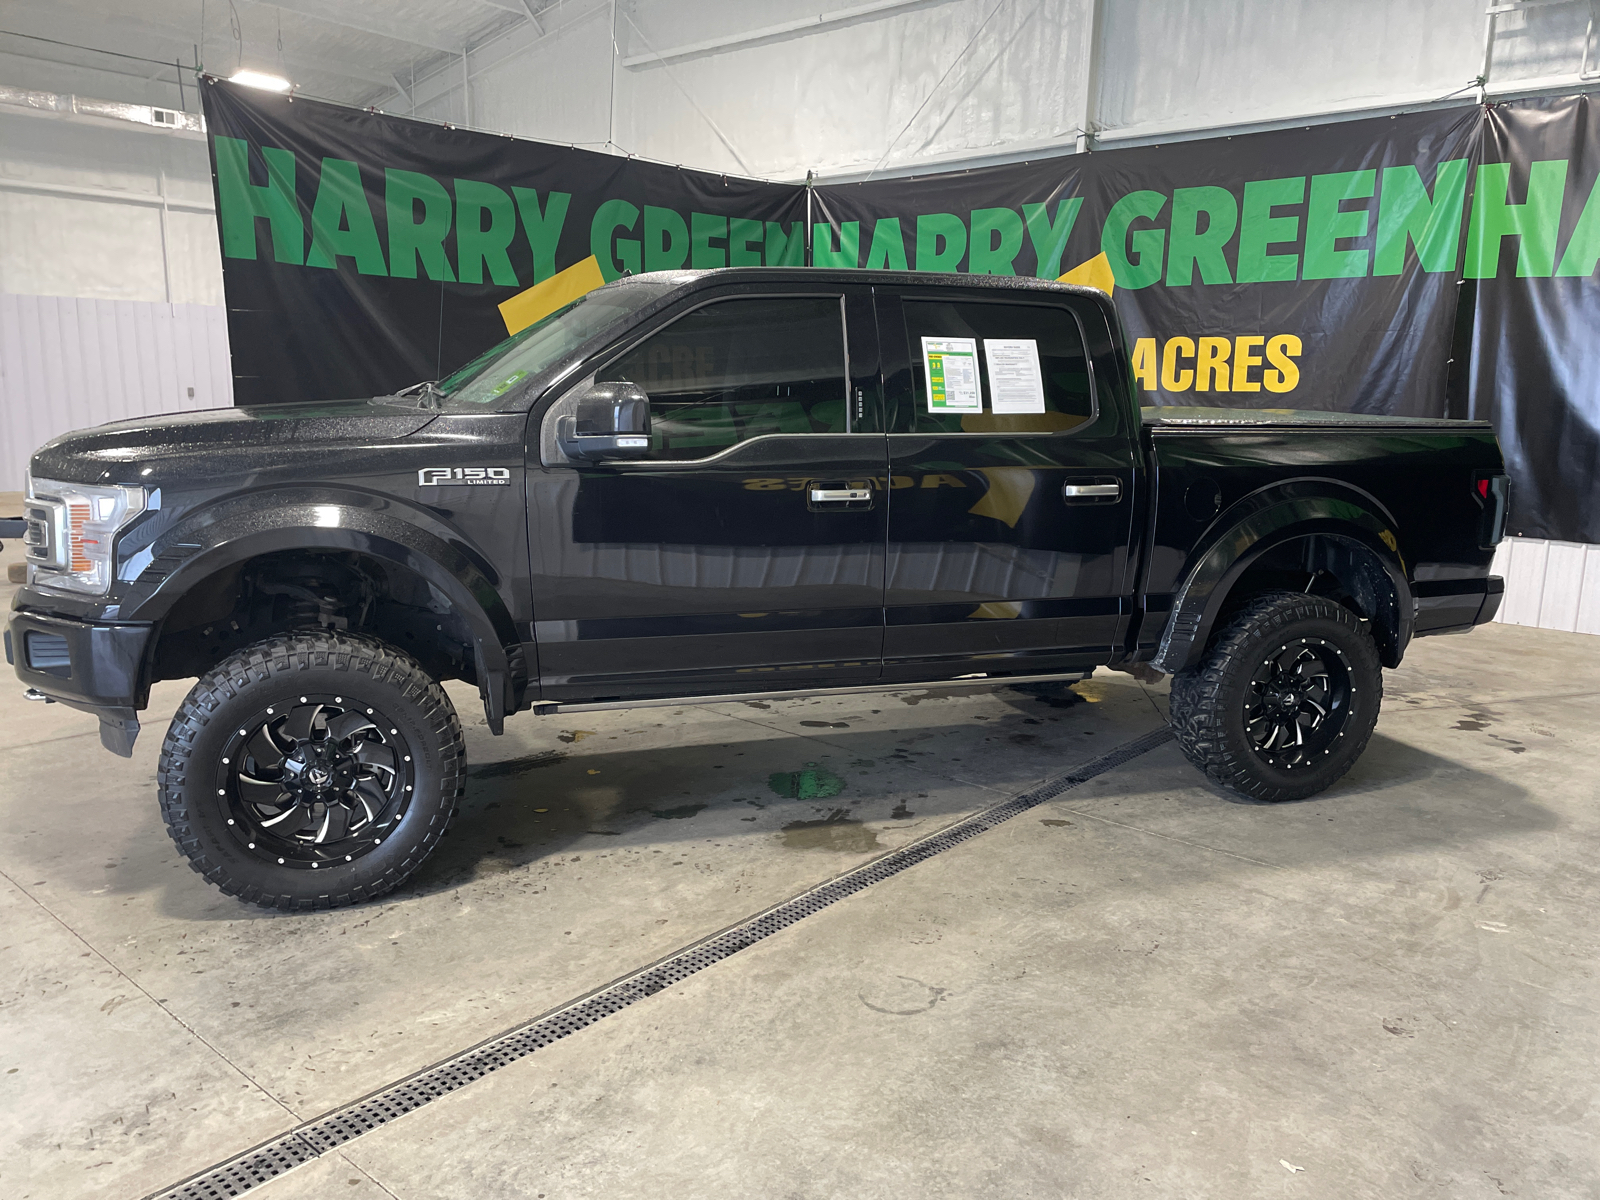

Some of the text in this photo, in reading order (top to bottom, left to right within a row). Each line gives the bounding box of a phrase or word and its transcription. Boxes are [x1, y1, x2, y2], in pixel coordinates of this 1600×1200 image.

[215, 135, 804, 287] HARRY GREEN
[813, 158, 1469, 290] HARRY GREEN
[1132, 334, 1302, 393] ACRES
